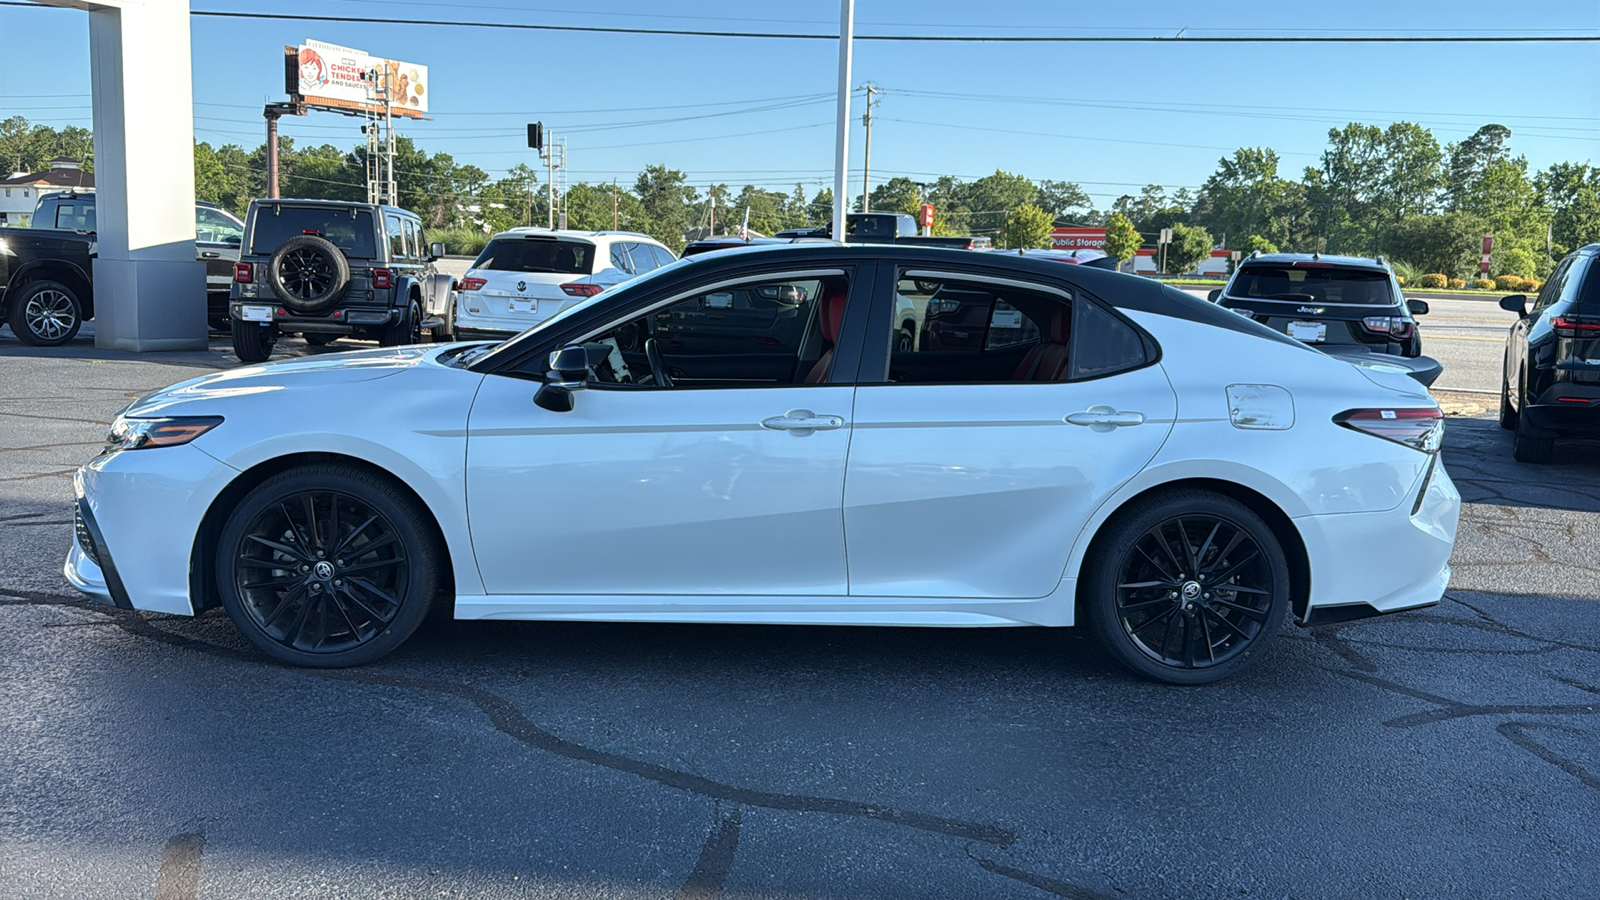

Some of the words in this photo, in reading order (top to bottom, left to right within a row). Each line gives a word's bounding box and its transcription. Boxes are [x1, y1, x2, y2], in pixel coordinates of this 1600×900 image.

[331, 71, 366, 83] TENDER
[345, 81, 366, 89] SAUCES
[1052, 238, 1075, 246] Public
[1296, 306, 1323, 315] Jeep
